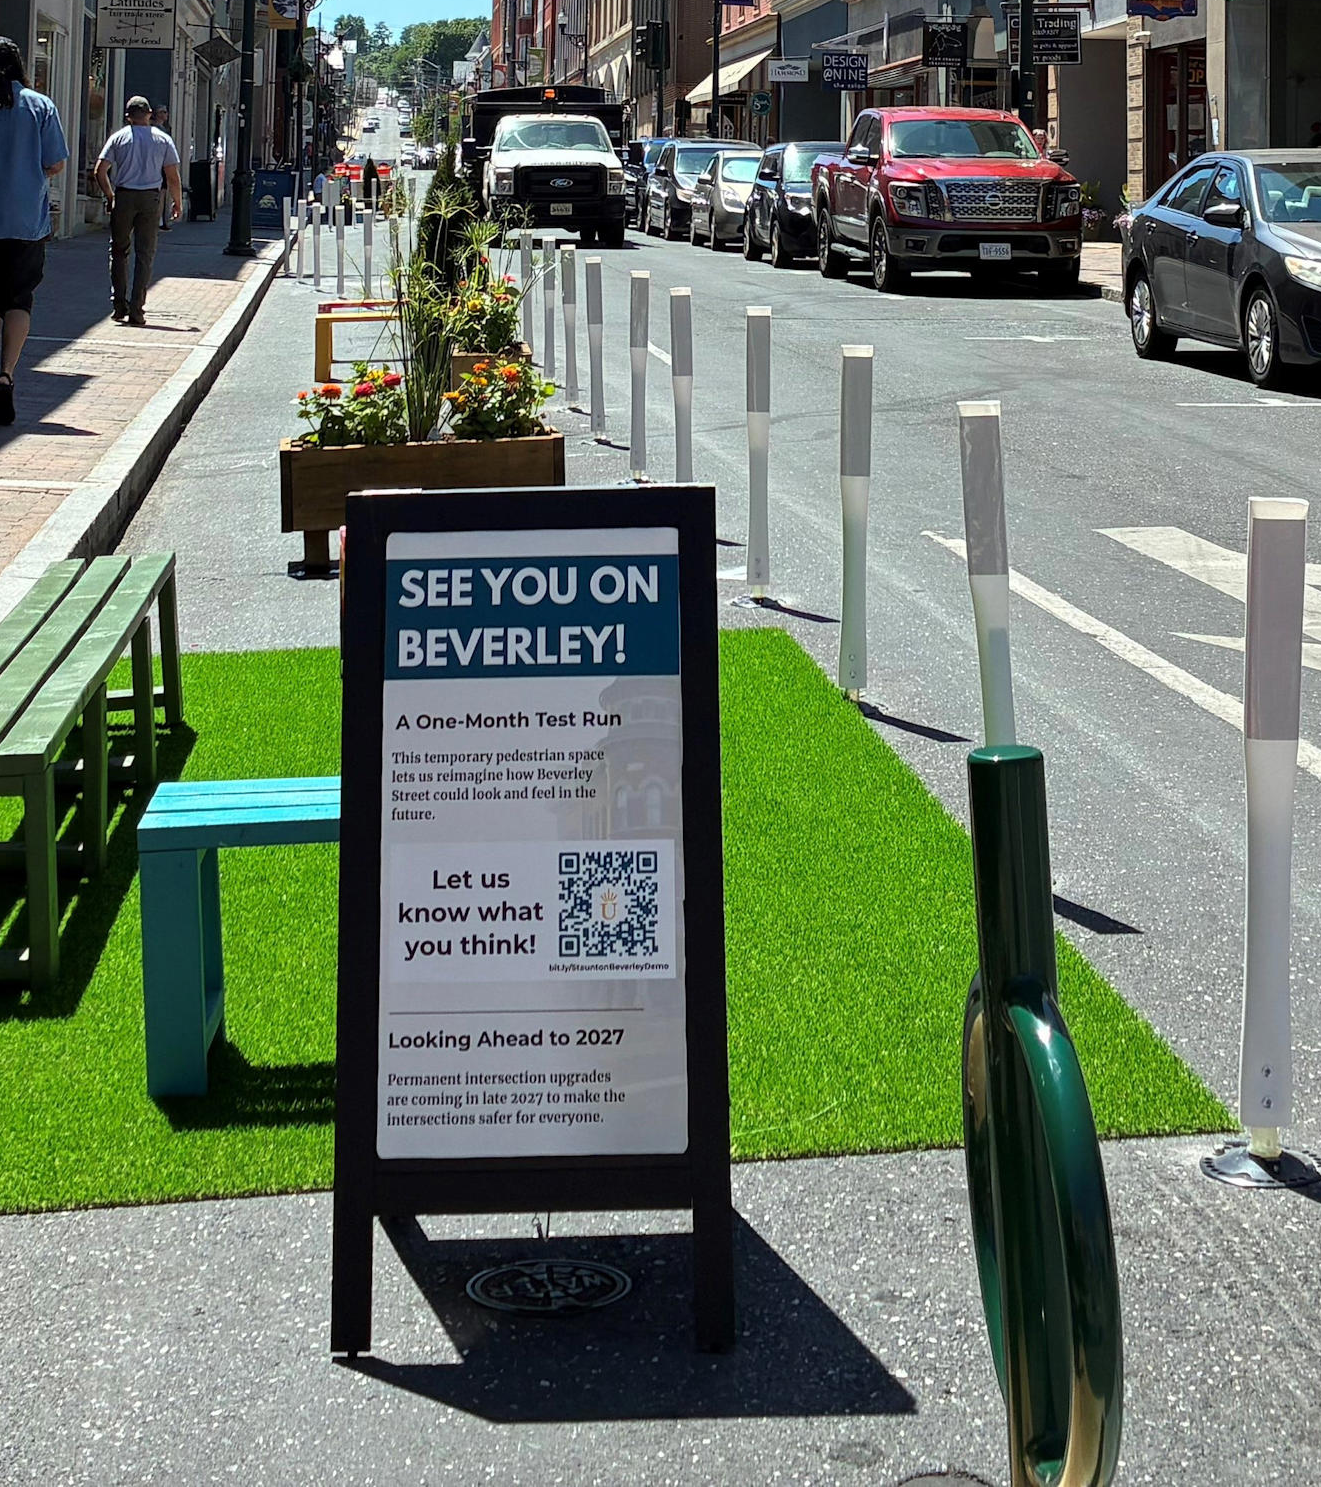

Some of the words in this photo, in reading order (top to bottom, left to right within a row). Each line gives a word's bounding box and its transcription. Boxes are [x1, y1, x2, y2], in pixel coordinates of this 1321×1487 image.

[1036, 17, 1076, 30] Trading
[109, 37, 127, 45] Shop
[141, 37, 161, 45] Good
[823, 55, 866, 67] DESIGN
[823, 70, 866, 81] @NINE
[398, 568, 473, 608] SEE
[480, 566, 577, 607] YOU
[589, 565, 659, 604] ON
[398, 624, 626, 668] BEVERLEY!
[395, 714, 411, 731] A
[416, 713, 529, 730] One-Month
[535, 711, 577, 728] Test
[582, 711, 622, 727] Run
[392, 751, 421, 764] This
[424, 751, 493, 766] temporary
[496, 749, 565, 765] pedestrian
[568, 749, 605, 764] space
[392, 770, 416, 783] lets
[418, 772, 433, 782] us
[437, 769, 503, 784] reimagine
[506, 768, 534, 781] how
[537, 768, 593, 783] Beverley
[391, 787, 430, 802] Street
[433, 787, 469, 801] could
[472, 787, 501, 800] look
[504, 786, 529, 800] and
[531, 785, 556, 799] feel
[558, 786, 572, 798] in
[575, 785, 596, 798] the
[391, 807, 435, 821] future.
[432, 870, 472, 889] Let
[481, 873, 510, 889] us
[399, 903, 470, 923] know
[478, 901, 544, 922] what
[405, 937, 452, 960] you
[460, 934, 536, 956] think!
[389, 1031, 471, 1050] Looking
[477, 1030, 543, 1047] Ahead
[549, 1031, 570, 1046] to
[576, 1029, 624, 1046] 2027
[388, 1073, 462, 1086] Permanent
[465, 1071, 546, 1085] intersection
[550, 1071, 611, 1086] upgrades
[387, 1095, 408, 1106] are
[411, 1093, 462, 1109] coming
[466, 1092, 478, 1105] in
[483, 1092, 507, 1105] late
[510, 1092, 543, 1107] 2027
[546, 1092, 561, 1103] to
[564, 1090, 600, 1103] make
[603, 1090, 626, 1103] the
[387, 1112, 475, 1126] intersections
[479, 1111, 513, 1125] safer
[516, 1111, 536, 1124] for
[538, 1111, 604, 1126] everyone.
